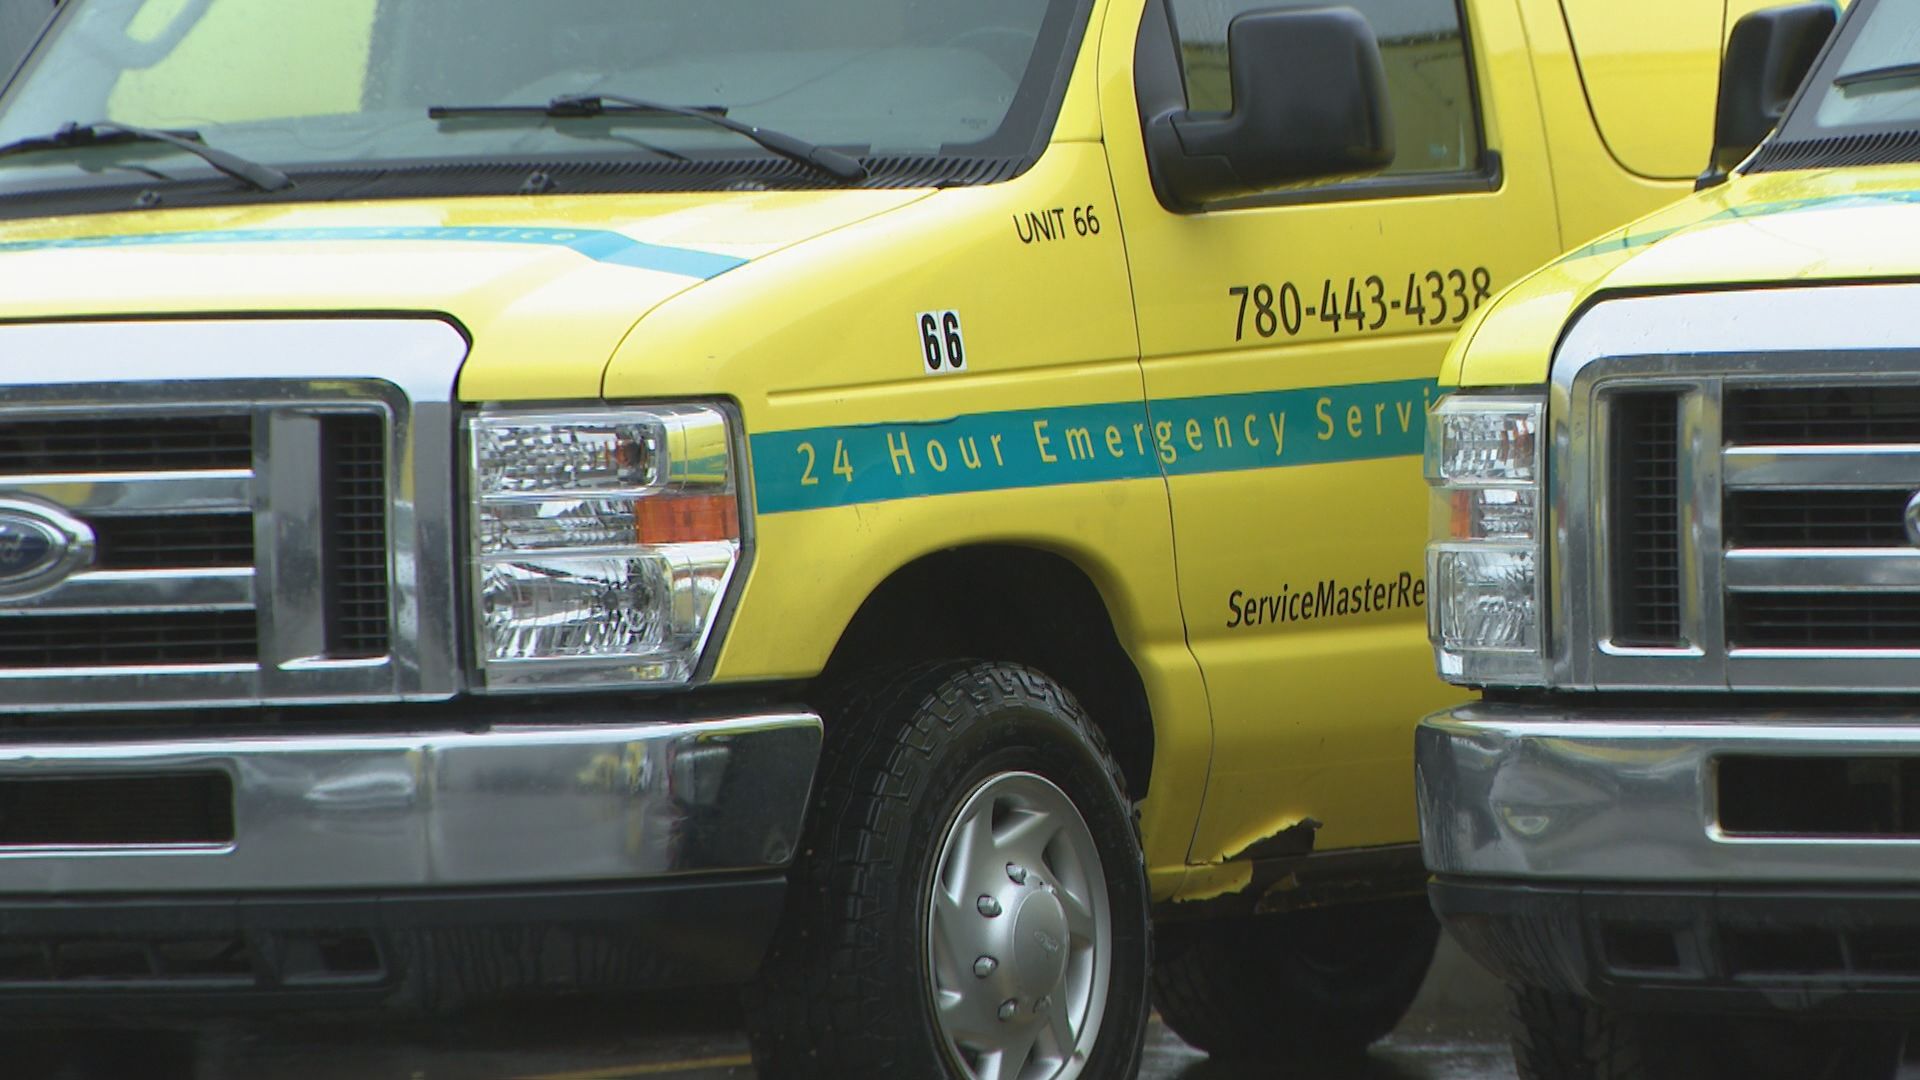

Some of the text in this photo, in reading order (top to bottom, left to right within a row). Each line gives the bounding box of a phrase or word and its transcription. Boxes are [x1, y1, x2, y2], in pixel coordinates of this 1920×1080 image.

[1013, 205, 1100, 244] UNIT 66
[1229, 267, 1491, 342] 780-443-4338
[921, 311, 963, 370] 66
[797, 438, 854, 486] 24
[886, 430, 1004, 476] Hour
[1032, 411, 1286, 464] Emergency
[1226, 571, 1426, 629] ServiceMasterRe
